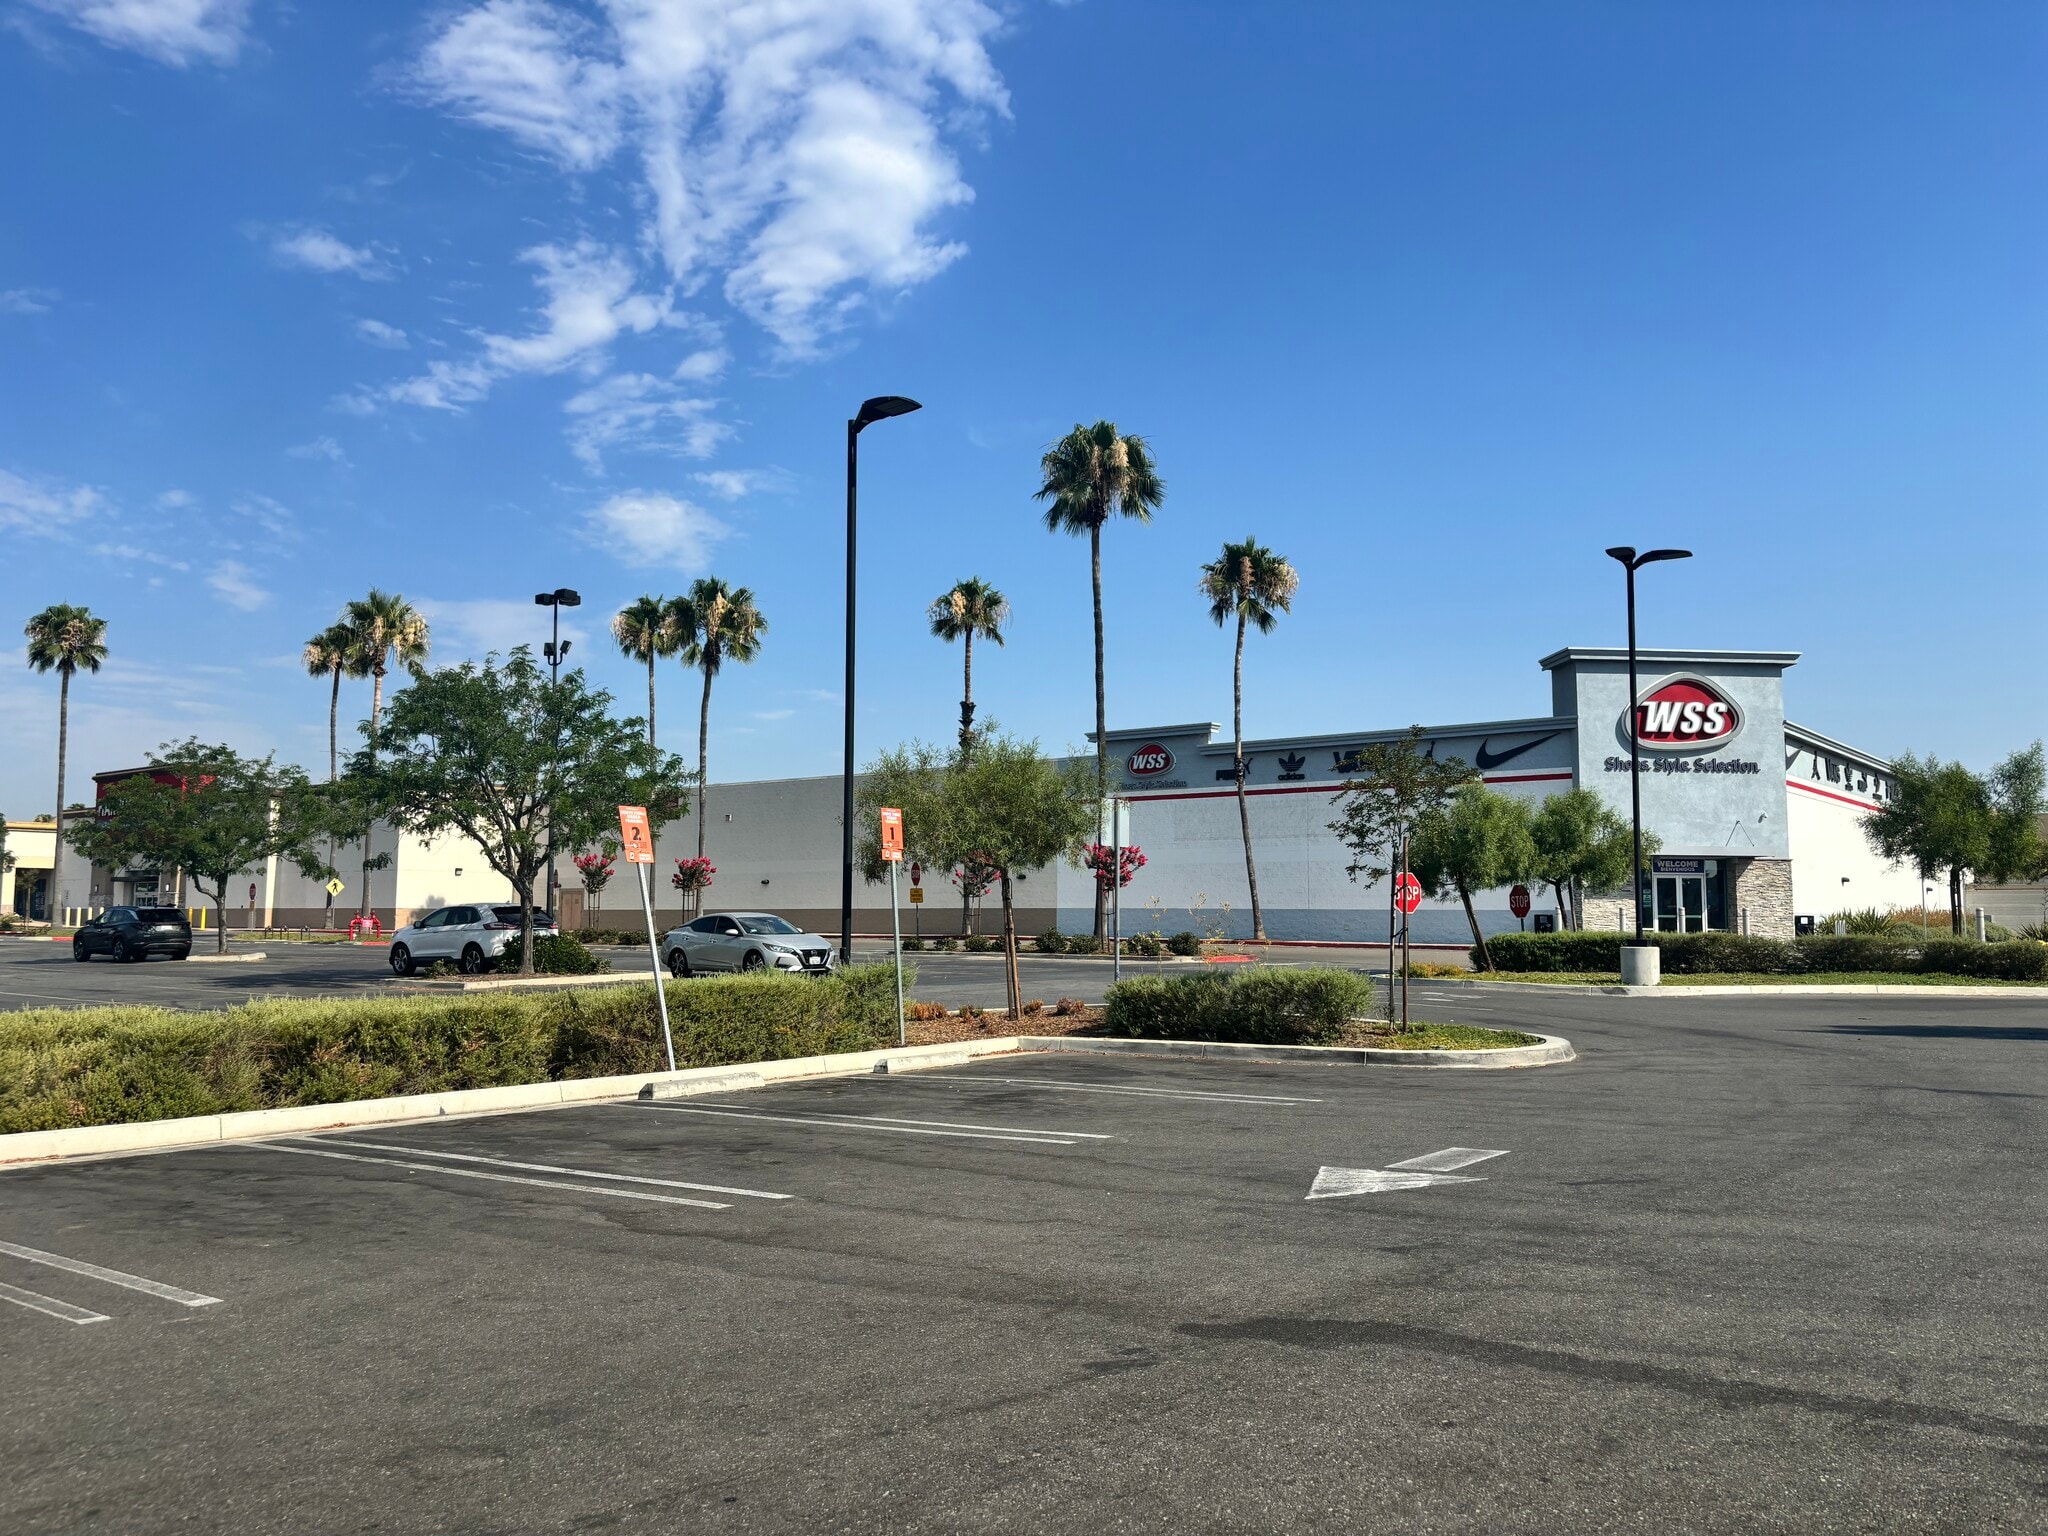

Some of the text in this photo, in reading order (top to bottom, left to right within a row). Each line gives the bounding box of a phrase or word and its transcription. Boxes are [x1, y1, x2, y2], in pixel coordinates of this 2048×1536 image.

[1640, 701, 1728, 734] WSS
[1132, 753, 1166, 770] WSS
[1603, 756, 1651, 772] Shos.
[890, 827, 894, 840] 1
[1657, 860, 1699, 868] WELCOME
[1394, 885, 1419, 900] SOP
[1510, 895, 1528, 908] STOP
